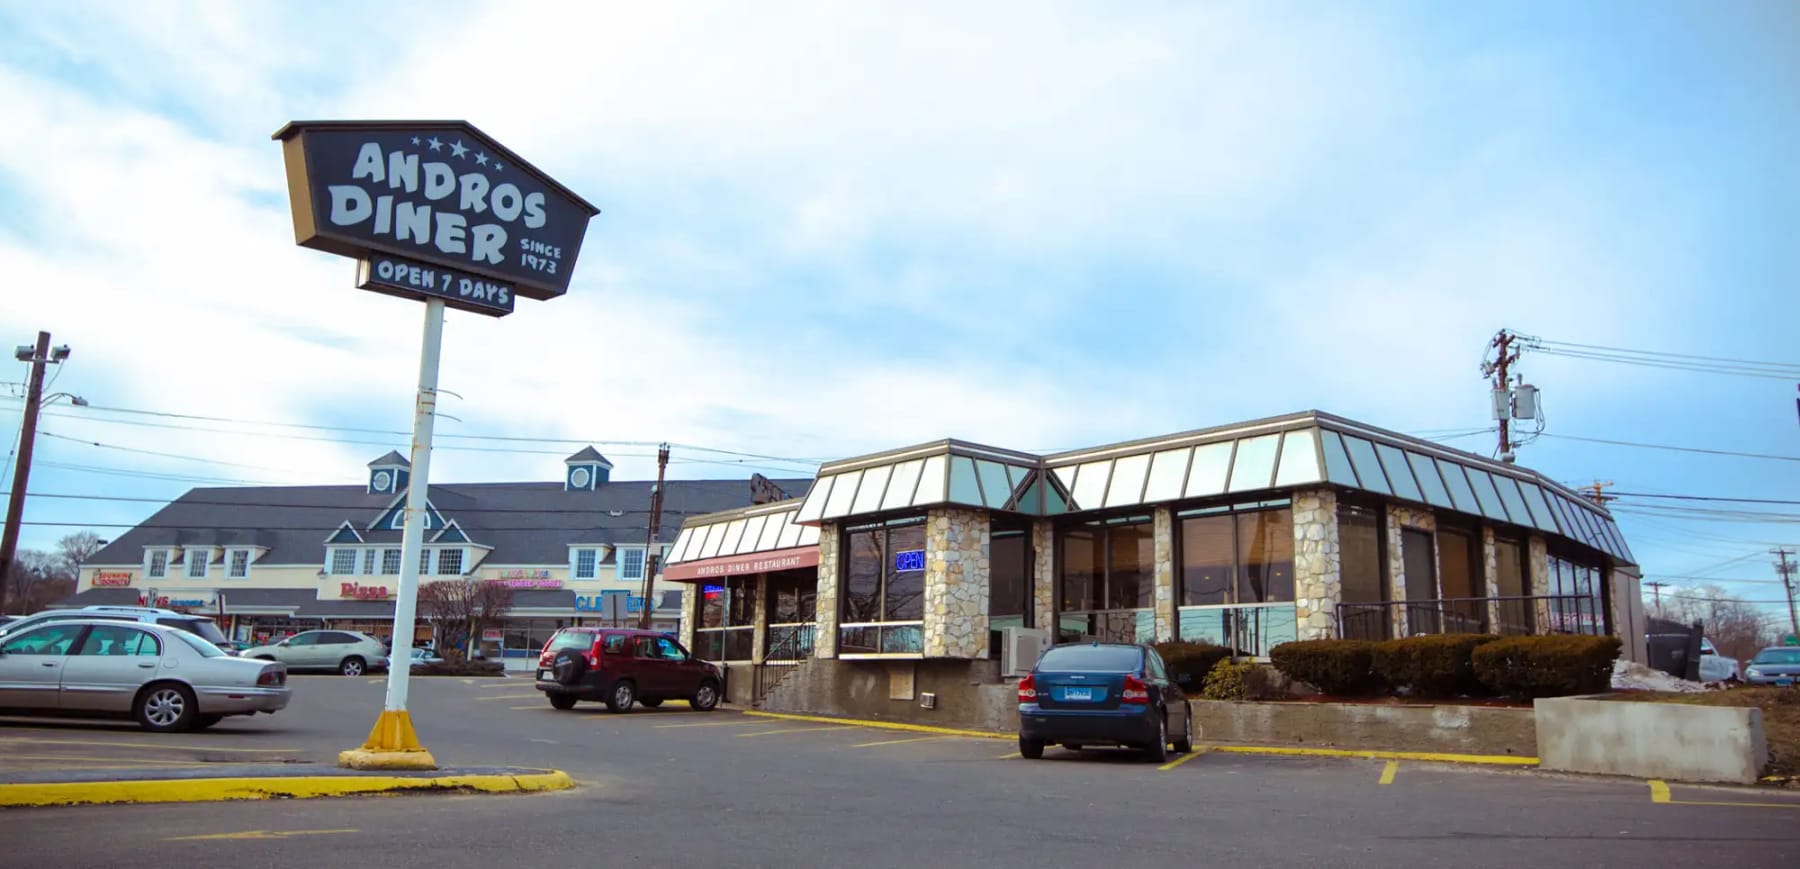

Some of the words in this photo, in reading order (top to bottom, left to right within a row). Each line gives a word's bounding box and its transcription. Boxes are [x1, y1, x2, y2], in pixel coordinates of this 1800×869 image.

[352, 142, 547, 229] ANDROS
[328, 185, 508, 265] DINER
[520, 238, 561, 259] SINCE
[521, 253, 557, 274] 1973
[377, 260, 435, 289] OPEN
[442, 274, 453, 292] 7
[459, 278, 509, 304] DAYS
[697, 564, 725, 575] ANDROS
[728, 562, 750, 572] DINER
[753, 557, 801, 570] RESTAURANT
[897, 552, 924, 570] OPEN
[340, 581, 388, 599] Pizza
